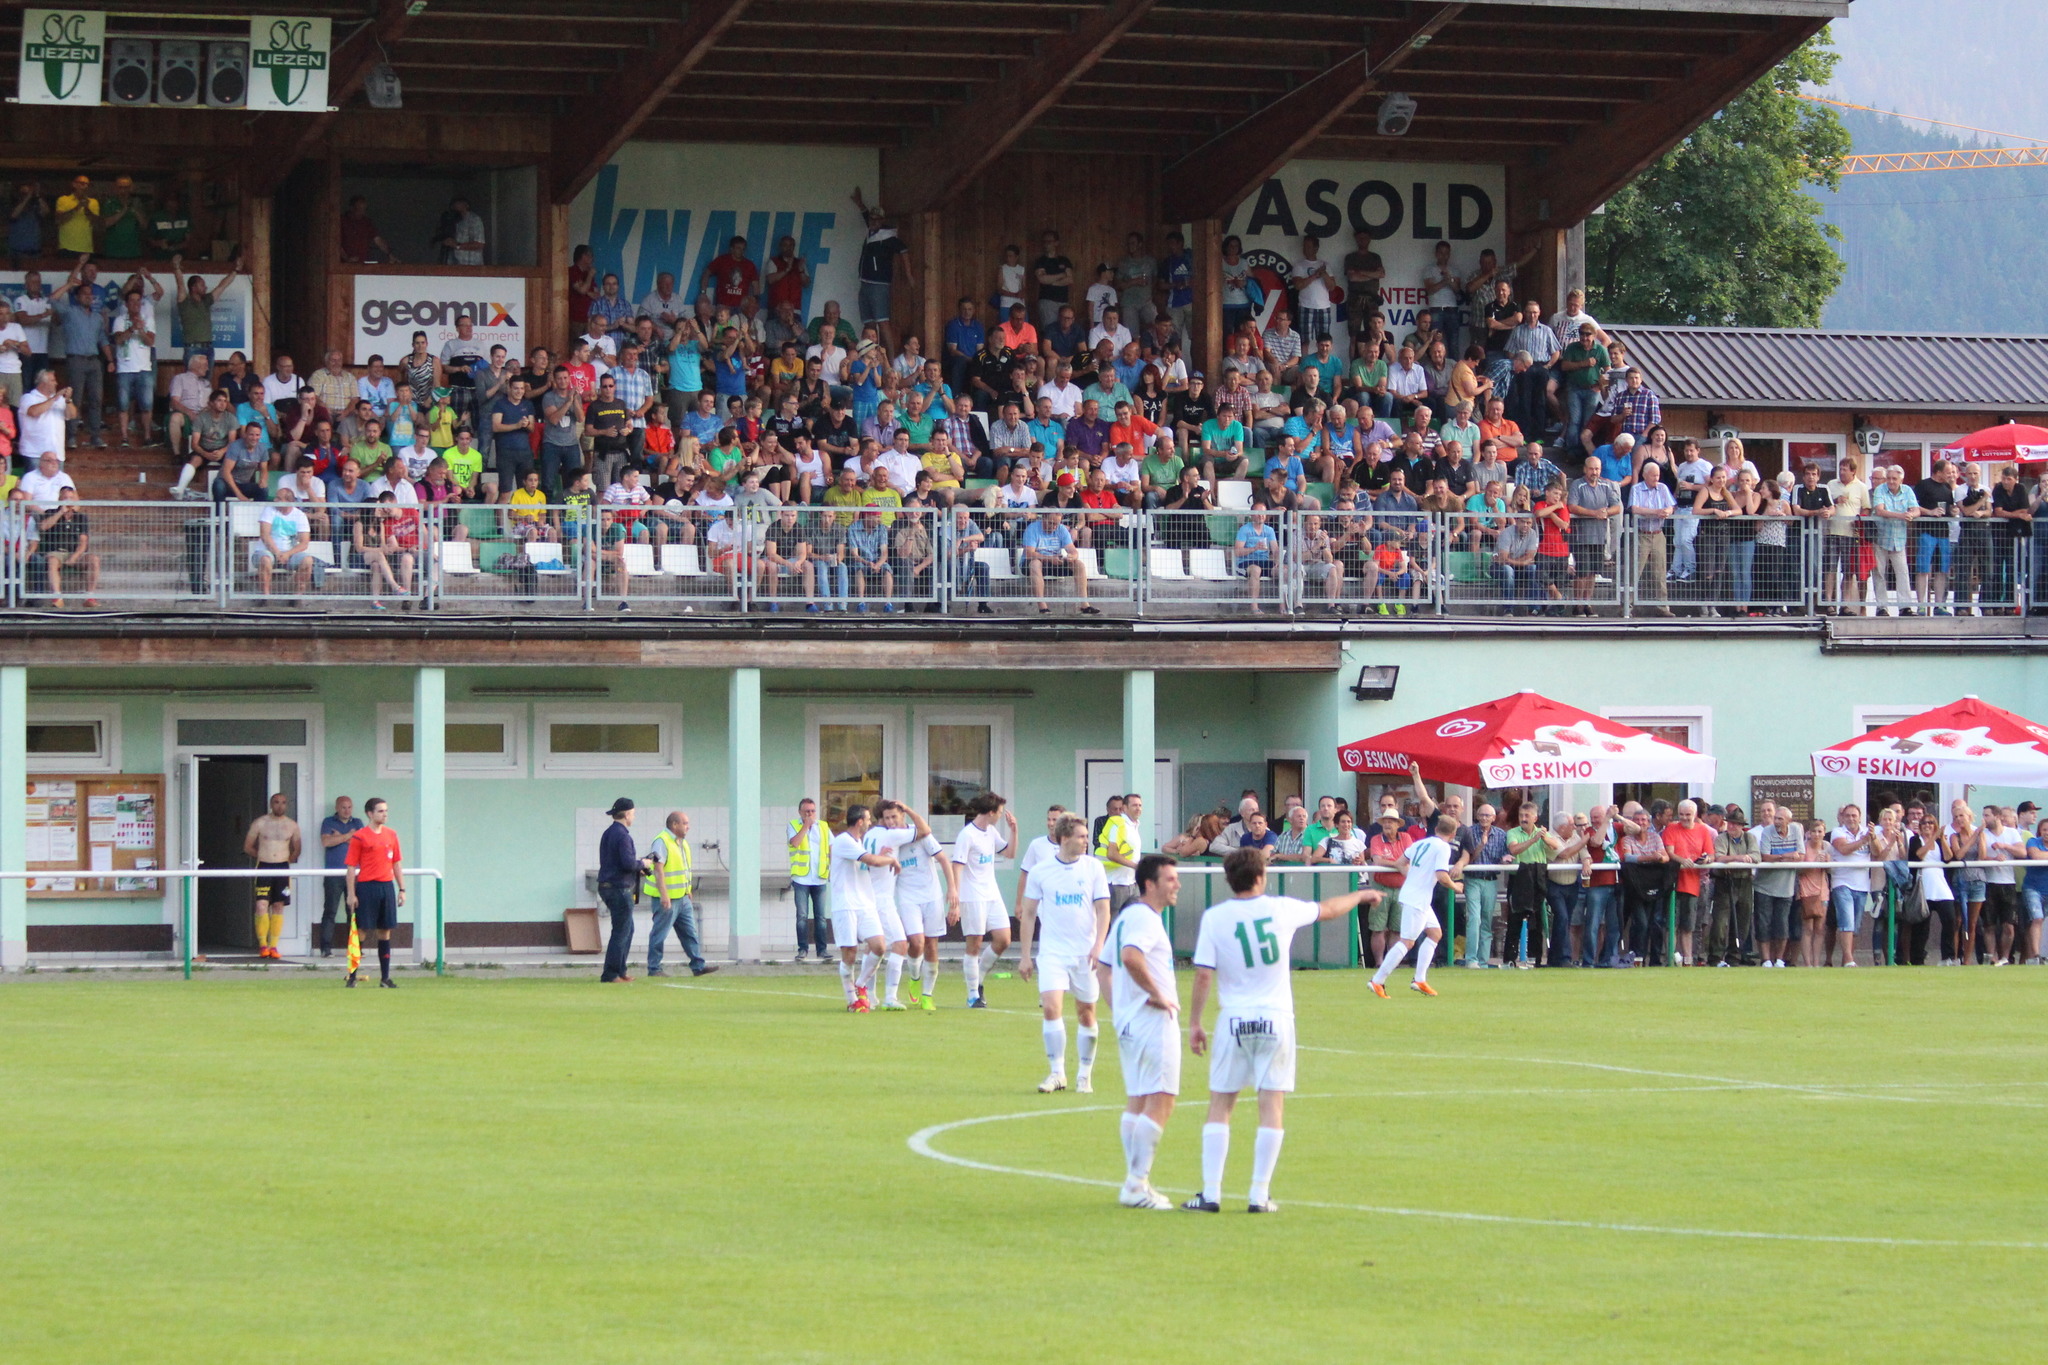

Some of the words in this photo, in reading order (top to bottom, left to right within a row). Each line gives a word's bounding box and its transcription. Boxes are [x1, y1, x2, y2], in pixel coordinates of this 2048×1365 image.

[30, 46, 96, 60] LIEZEN
[257, 53, 321, 66] LIEZEN
[361, 299, 519, 337] geomix
[1364, 750, 1408, 770] ESKIMO
[1522, 760, 1592, 780] ESKIMO
[1858, 757, 1937, 777] ESKIMO
[1412, 842, 1430, 867] 12
[1055, 890, 1084, 907] KNAUF
[1234, 917, 1280, 968] 15
